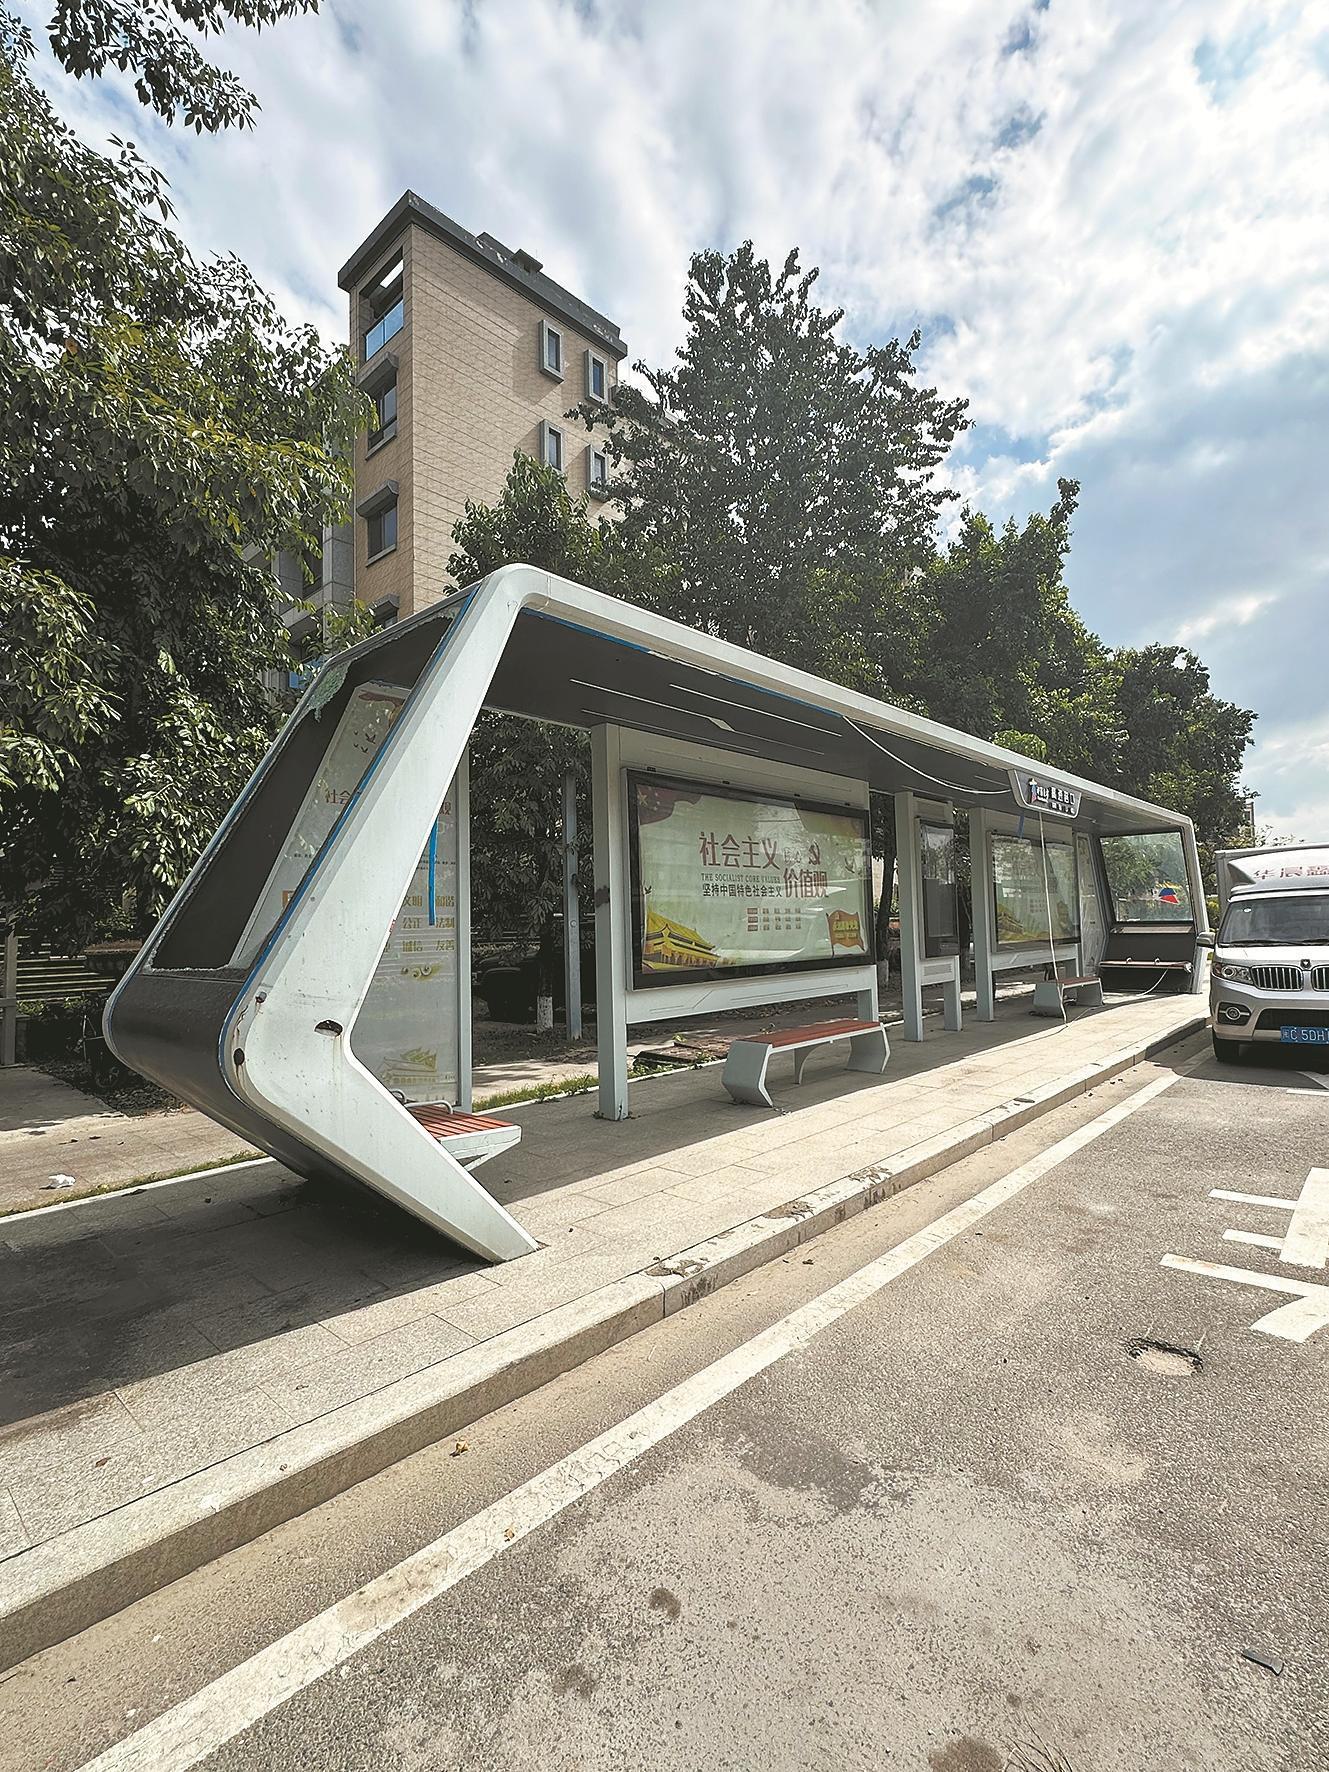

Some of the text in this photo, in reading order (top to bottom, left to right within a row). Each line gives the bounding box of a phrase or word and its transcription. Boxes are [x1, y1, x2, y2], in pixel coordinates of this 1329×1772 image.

[699, 831, 780, 870] 社会主义
[701, 872, 713, 881] THE
[715, 873, 743, 882] SOCIALIST
[745, 874, 760, 883] CORE
[783, 867, 829, 898] 价值观
[702, 883, 782, 898] 坚持中国特色社会主义
[402, 917, 422, 929] 公正
